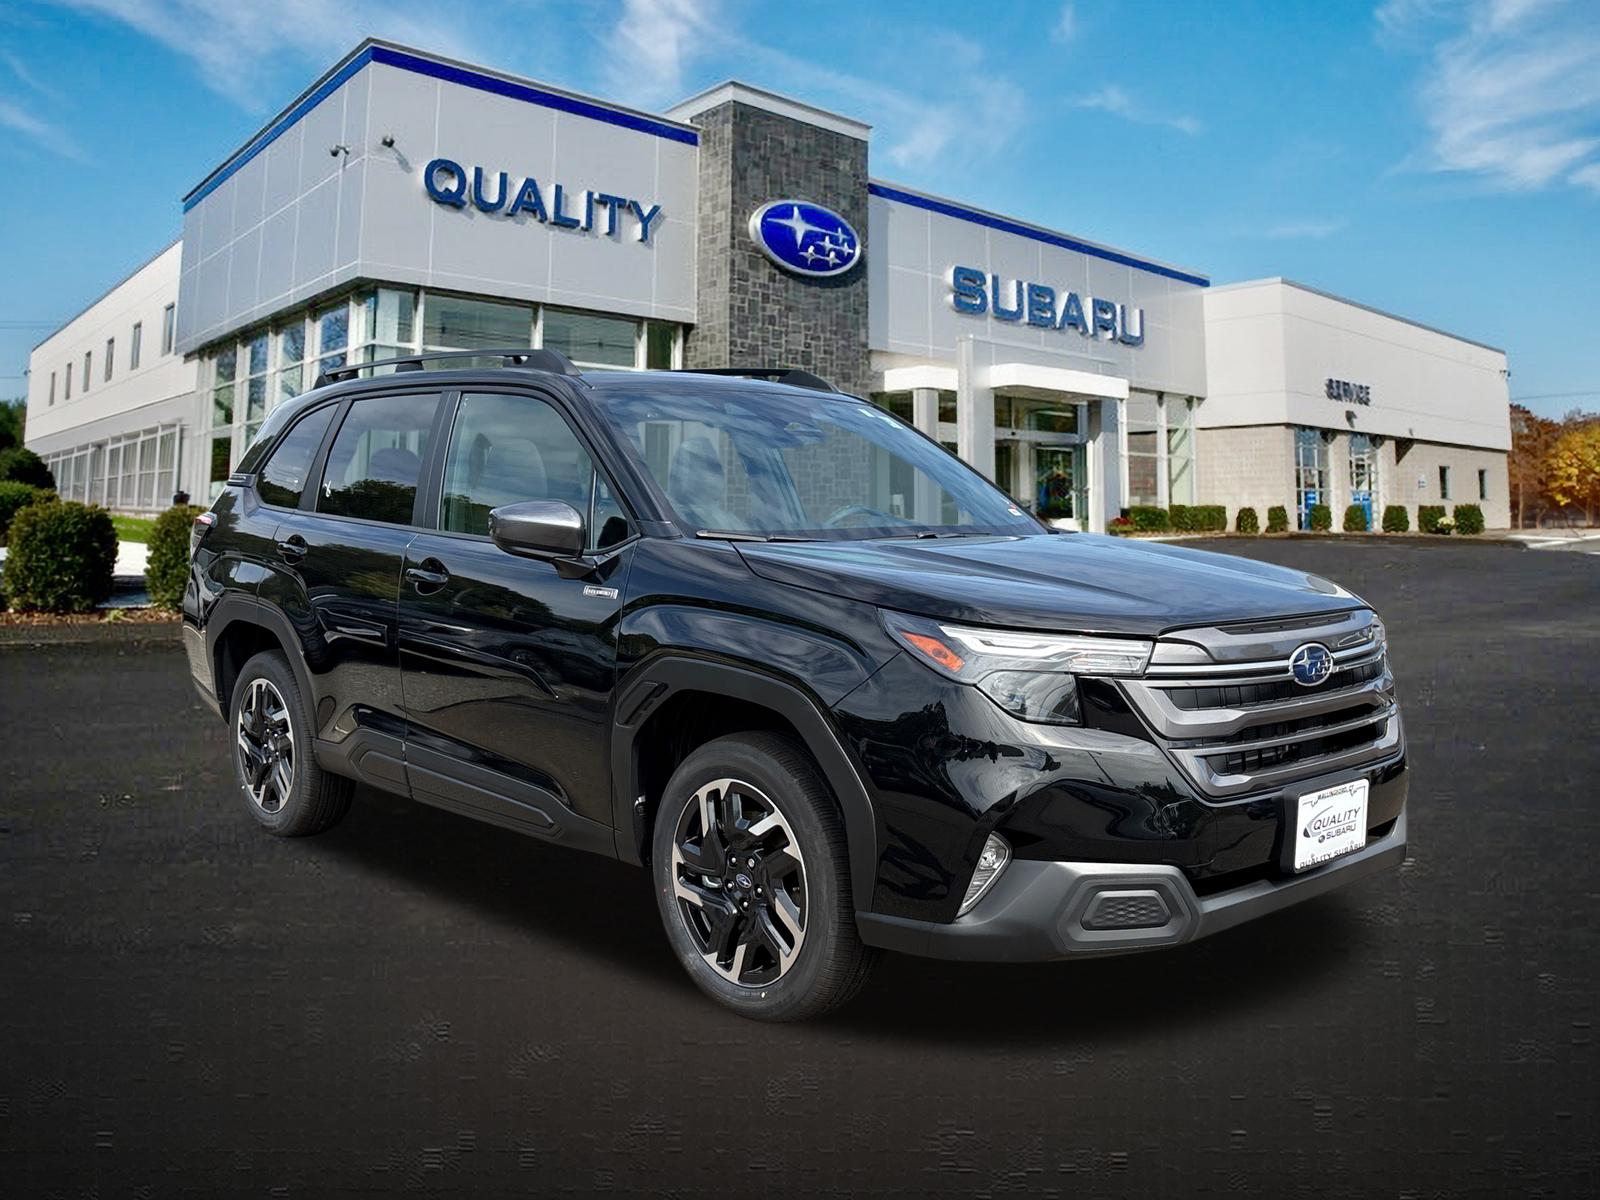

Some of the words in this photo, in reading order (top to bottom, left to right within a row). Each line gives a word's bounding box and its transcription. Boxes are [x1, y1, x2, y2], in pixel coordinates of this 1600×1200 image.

[423, 158, 662, 243] QUALITY
[949, 265, 1145, 347] SUBARU
[1313, 806, 1361, 831] QUALITY
[1326, 823, 1357, 840] SUBARU
